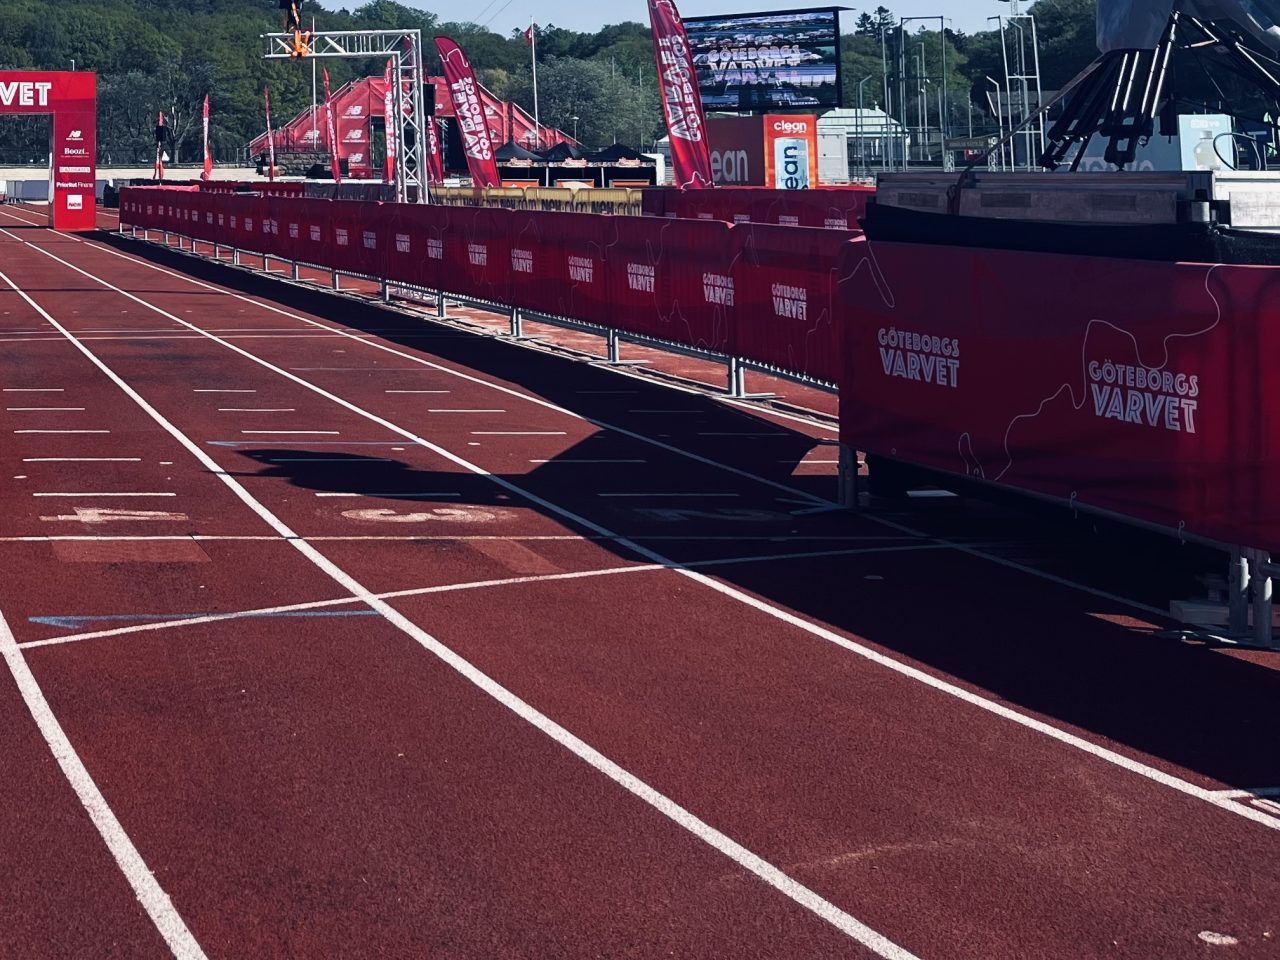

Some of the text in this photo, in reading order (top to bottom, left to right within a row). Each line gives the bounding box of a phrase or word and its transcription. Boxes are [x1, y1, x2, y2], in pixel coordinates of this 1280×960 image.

[658, 37, 691, 141] VARVET
[451, 78, 483, 160] VARVET
[463, 76, 491, 160] GÖTEBORGS
[774, 120, 807, 131] clean
[568, 265, 593, 283] VARVET
[627, 273, 655, 293] VARVET
[703, 284, 734, 307] VARVET
[772, 282, 807, 301] GÖTEBORGS
[772, 296, 807, 321] VARVET
[877, 326, 960, 357] GÖTEBORGS
[879, 347, 960, 388] VARVET
[1088, 358, 1199, 397] GÖTEBORGS
[1090, 383, 1198, 434] VARVET
